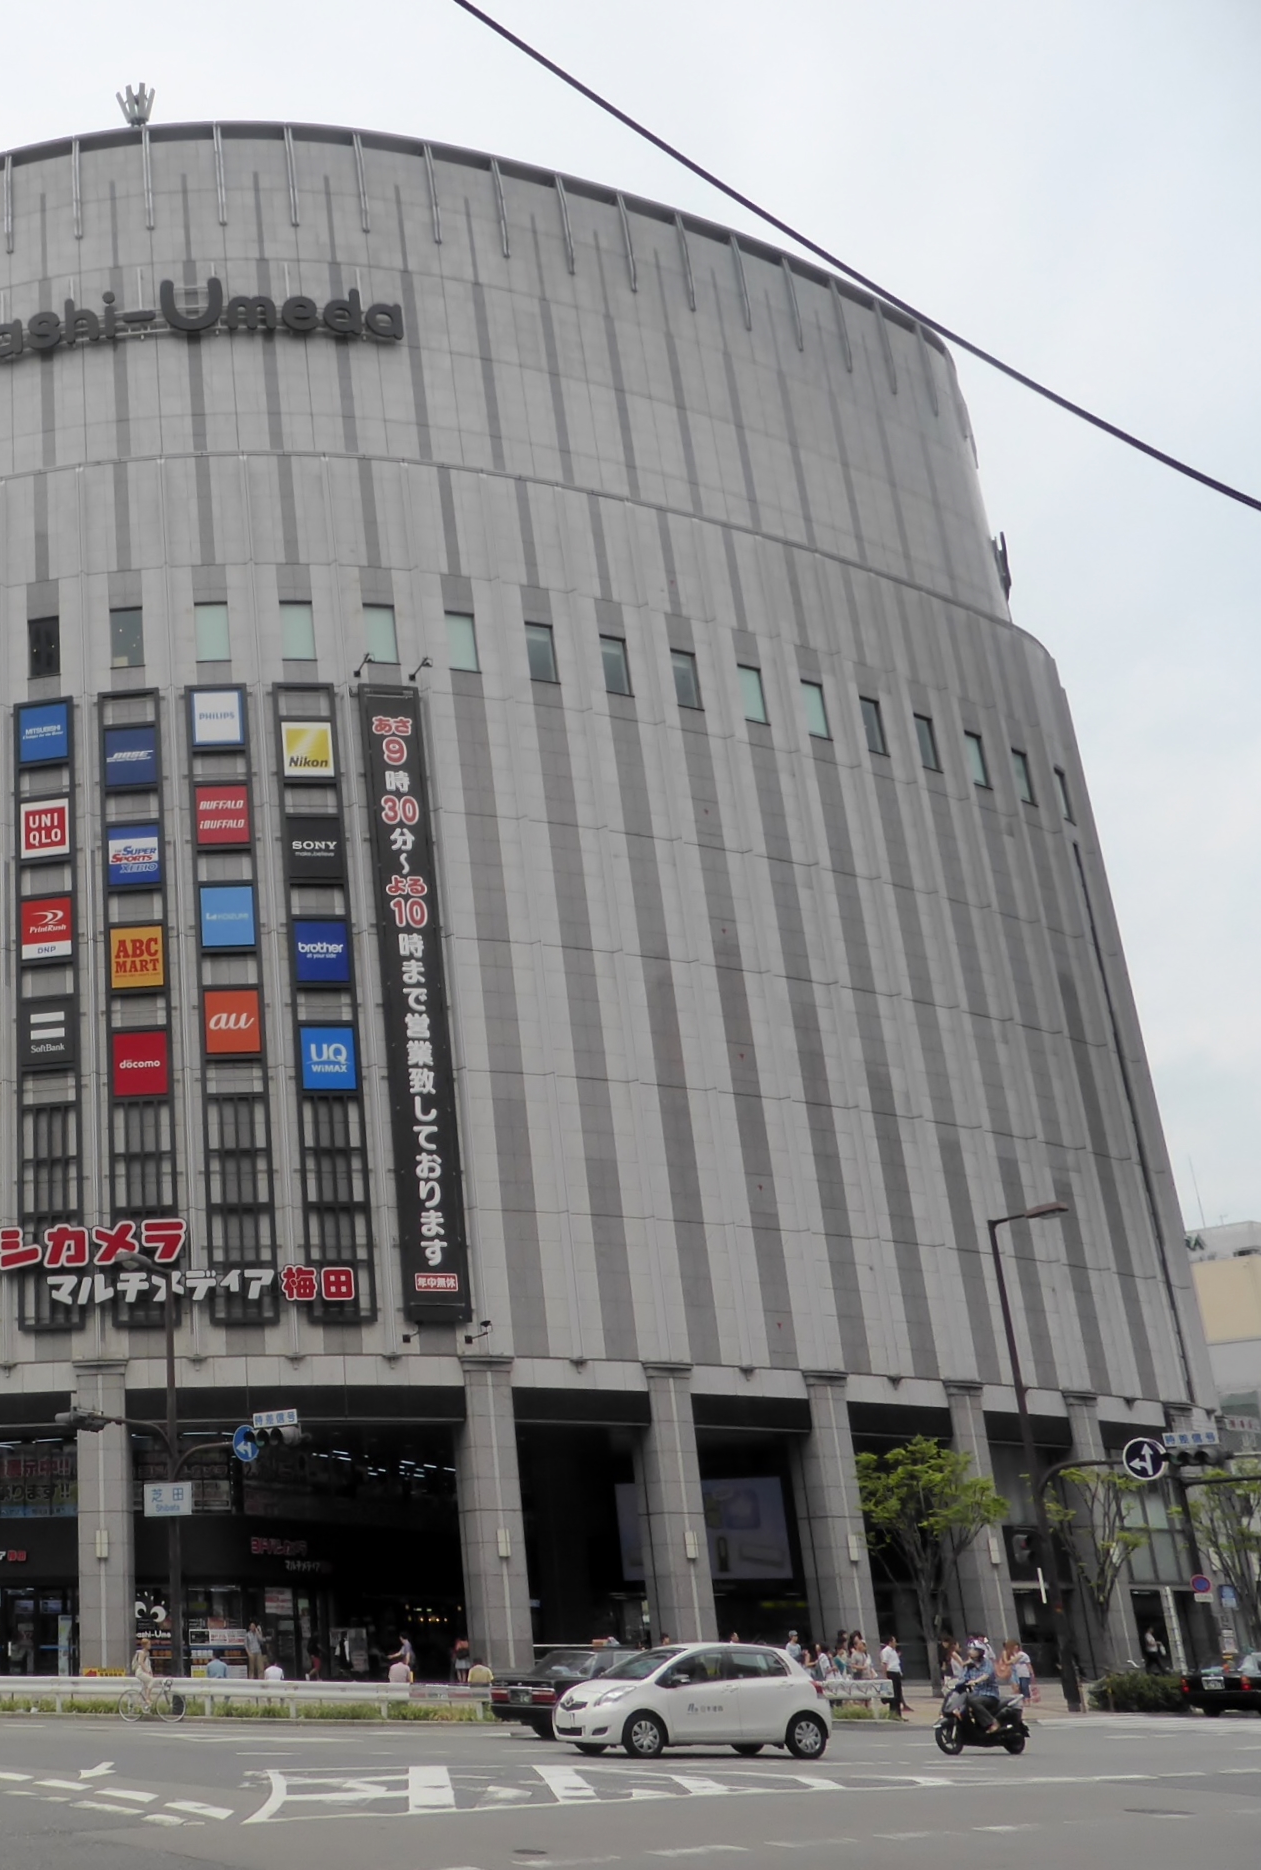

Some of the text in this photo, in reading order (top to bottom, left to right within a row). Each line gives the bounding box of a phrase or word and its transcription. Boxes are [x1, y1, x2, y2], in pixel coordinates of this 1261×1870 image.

[198, 711, 235, 720] PHILIPS
[289, 756, 329, 768] Nikon
[199, 799, 244, 810] BUFFALO
[29, 813, 58, 829] UNI
[199, 819, 245, 830] iBUFFALO
[29, 828, 61, 847] QLO
[292, 840, 337, 850] SONY
[119, 863, 158, 874] XEBIO
[29, 923, 67, 934] PrintRush
[37, 945, 57, 955] DNP
[115, 937, 159, 959] ABC
[298, 942, 344, 954] brother
[115, 958, 160, 974] MART
[209, 1012, 254, 1031] au
[31, 1043, 66, 1054] SoftBank
[310, 1043, 347, 1062] UQ
[311, 1064, 348, 1074] WiMAX
[46, 1264, 355, 1305] マルチメディア梅田
[417, 1277, 456, 1288] 年中無休
[151, 1487, 184, 1503] 芝田
[155, 1504, 180, 1513] Shibata
